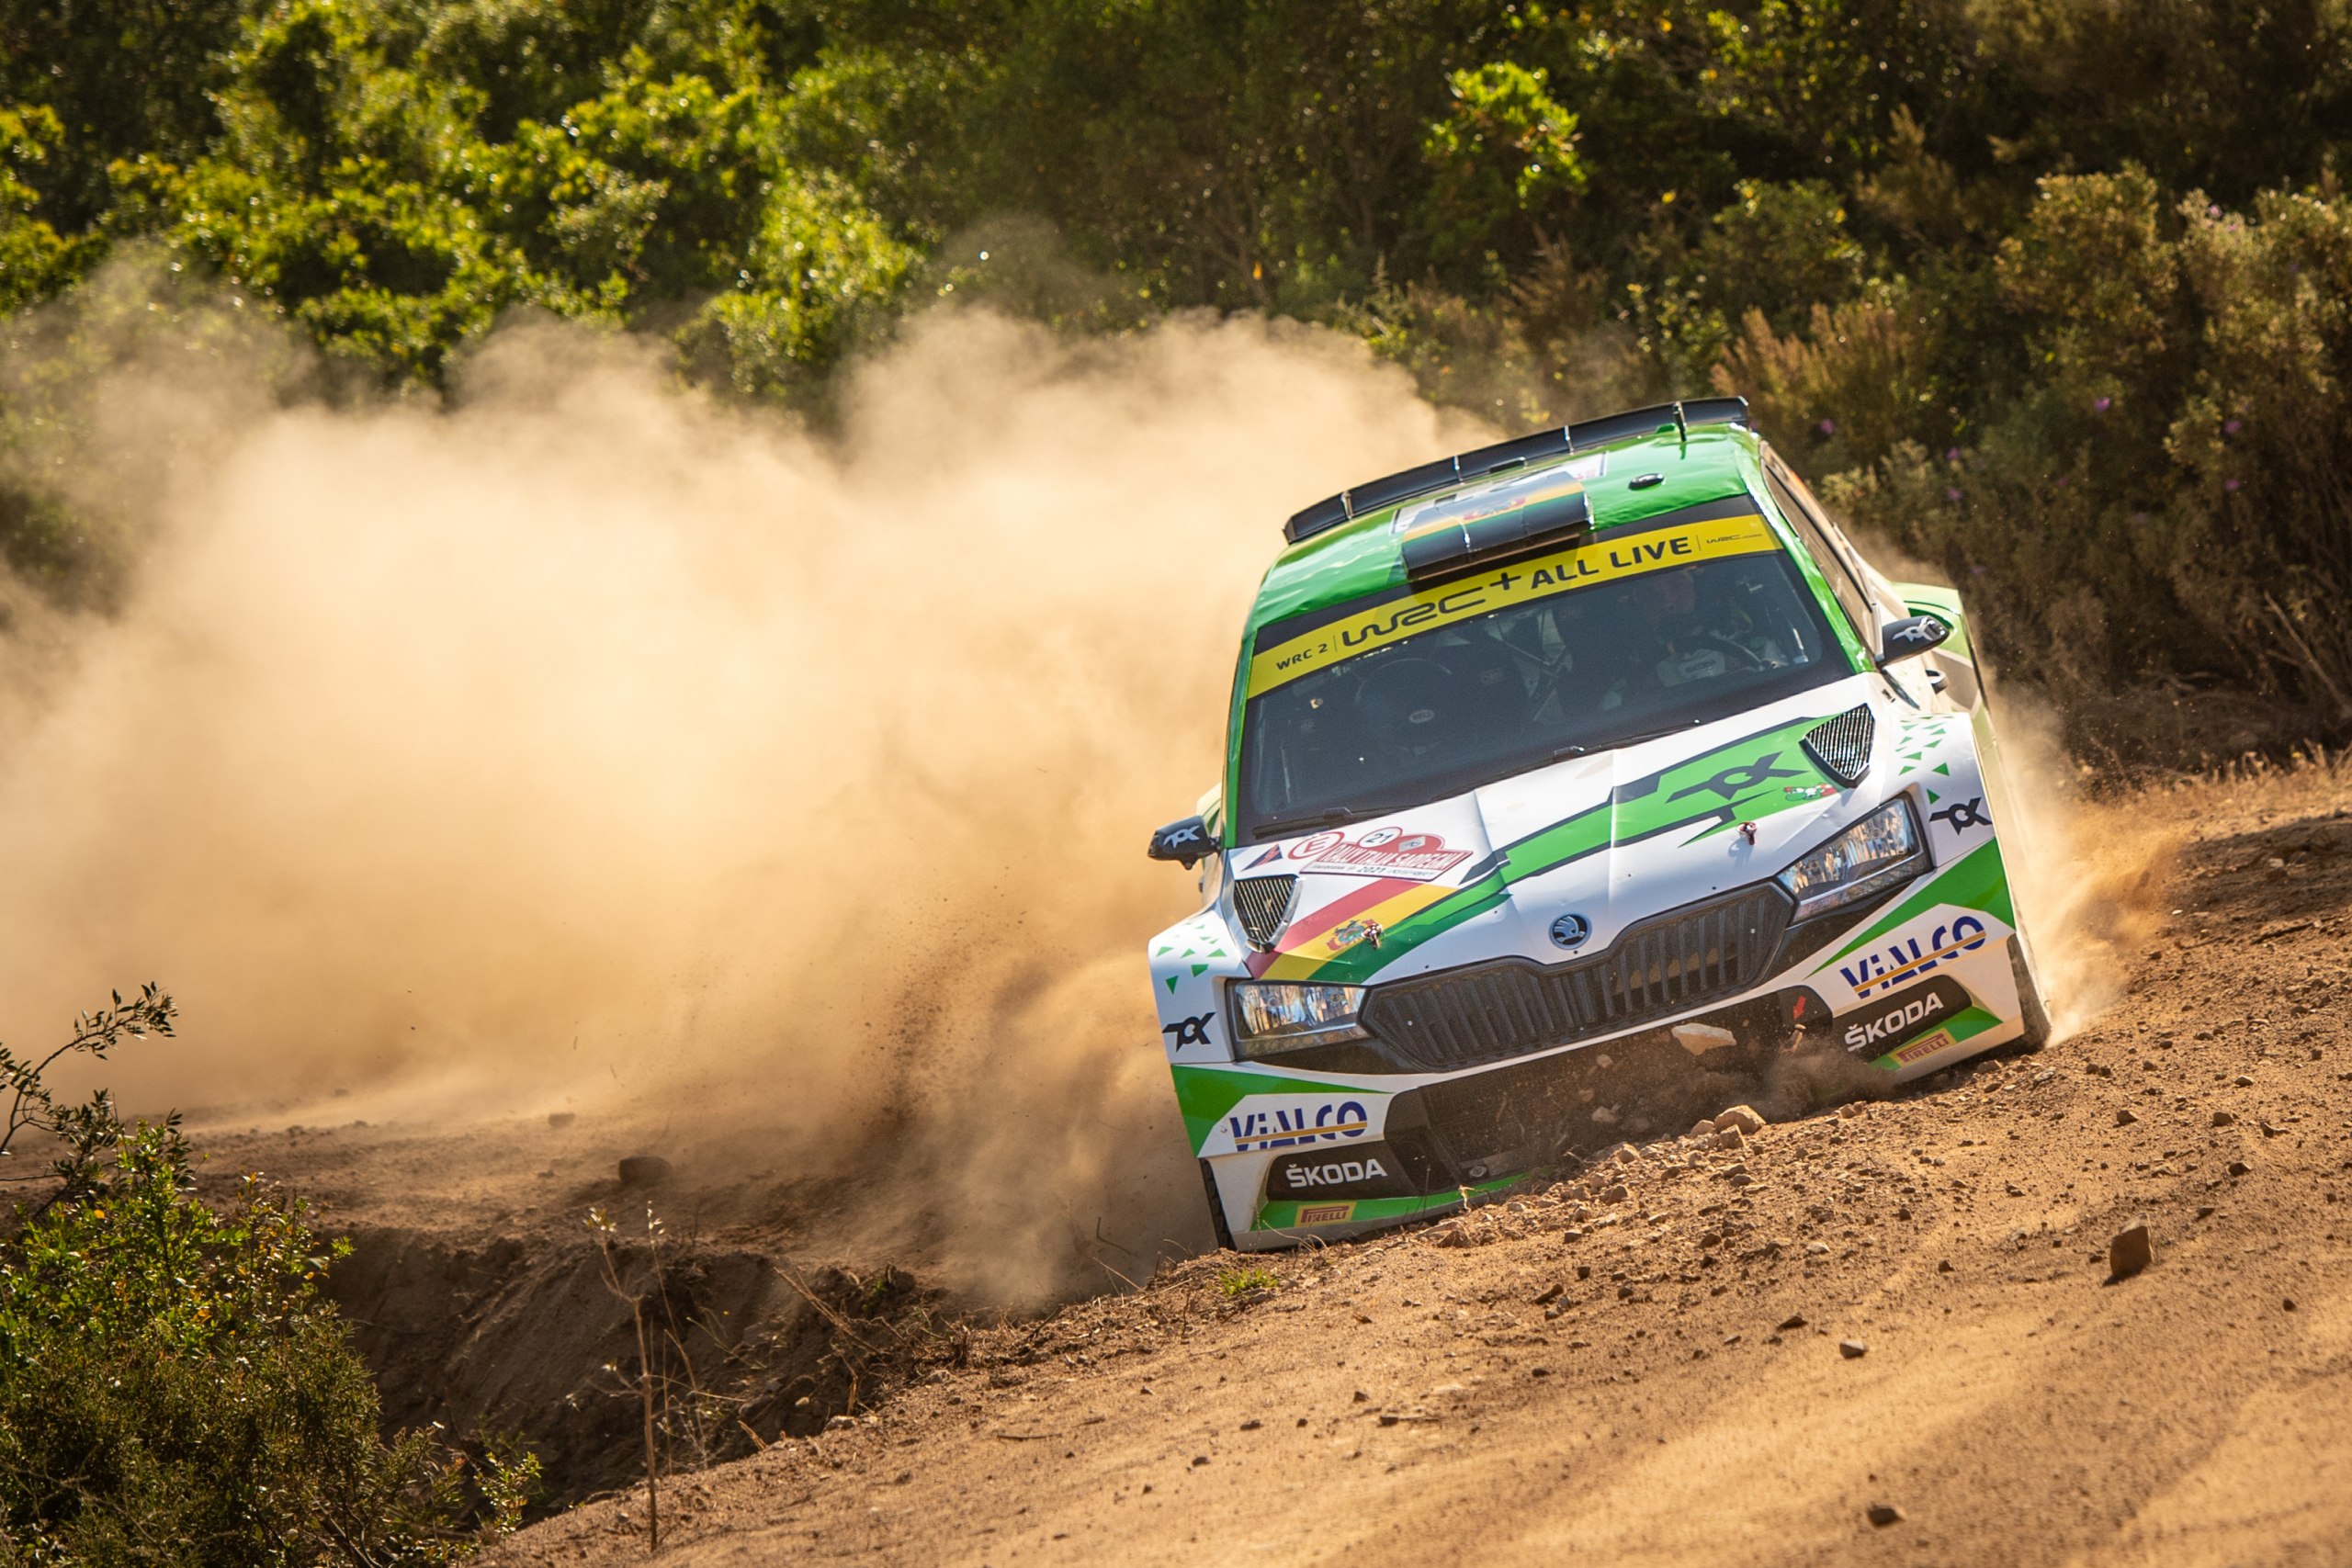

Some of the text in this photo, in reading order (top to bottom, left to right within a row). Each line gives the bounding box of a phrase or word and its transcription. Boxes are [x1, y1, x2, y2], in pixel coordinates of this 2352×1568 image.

[1276, 649, 1313, 670] WRC
[1317, 643, 1329, 654] 2
[1530, 558, 1600, 590] ALL
[1611, 536, 1693, 568] LIVE
[1365, 831, 1394, 844] 21
[1844, 992, 1944, 1052] ŠKODA
[1896, 1032, 1950, 1063] PIRELLI
[1285, 1158, 1387, 1188] ŠKODA
[1300, 1205, 1349, 1223] PIRELLI
